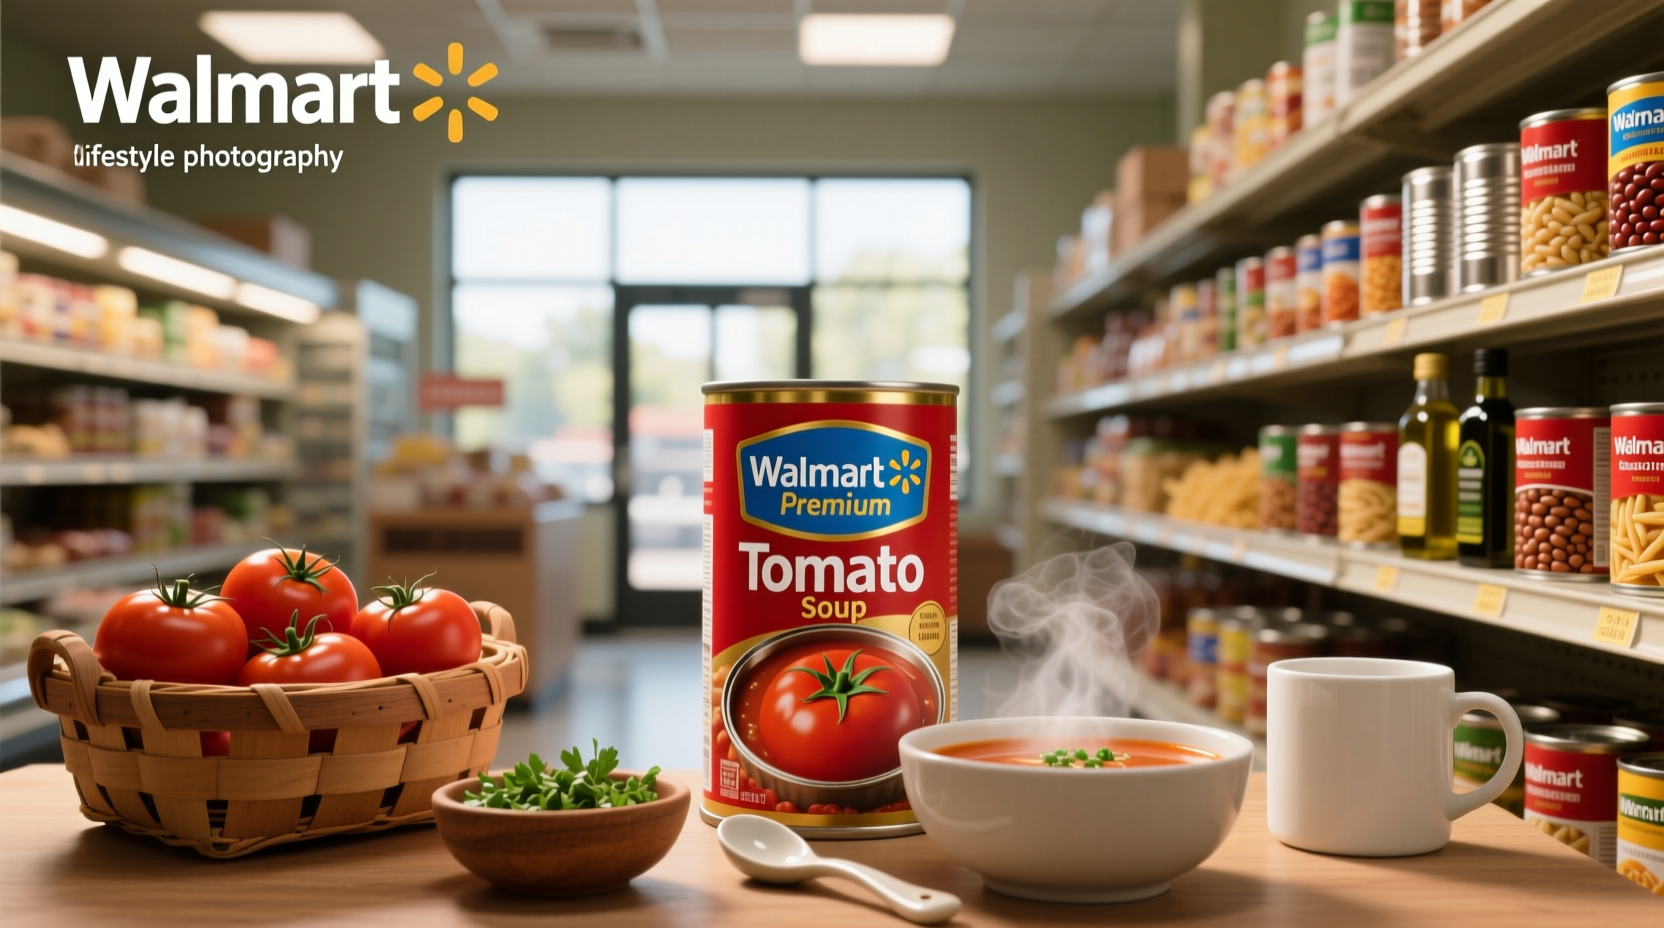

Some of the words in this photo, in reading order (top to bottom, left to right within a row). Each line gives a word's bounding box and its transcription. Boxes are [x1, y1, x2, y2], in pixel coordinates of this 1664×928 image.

[750, 455, 885, 488] Walmart
[780, 491, 891, 516] Premium
[738, 542, 925, 593] Tomato
[801, 596, 867, 624] Soup
